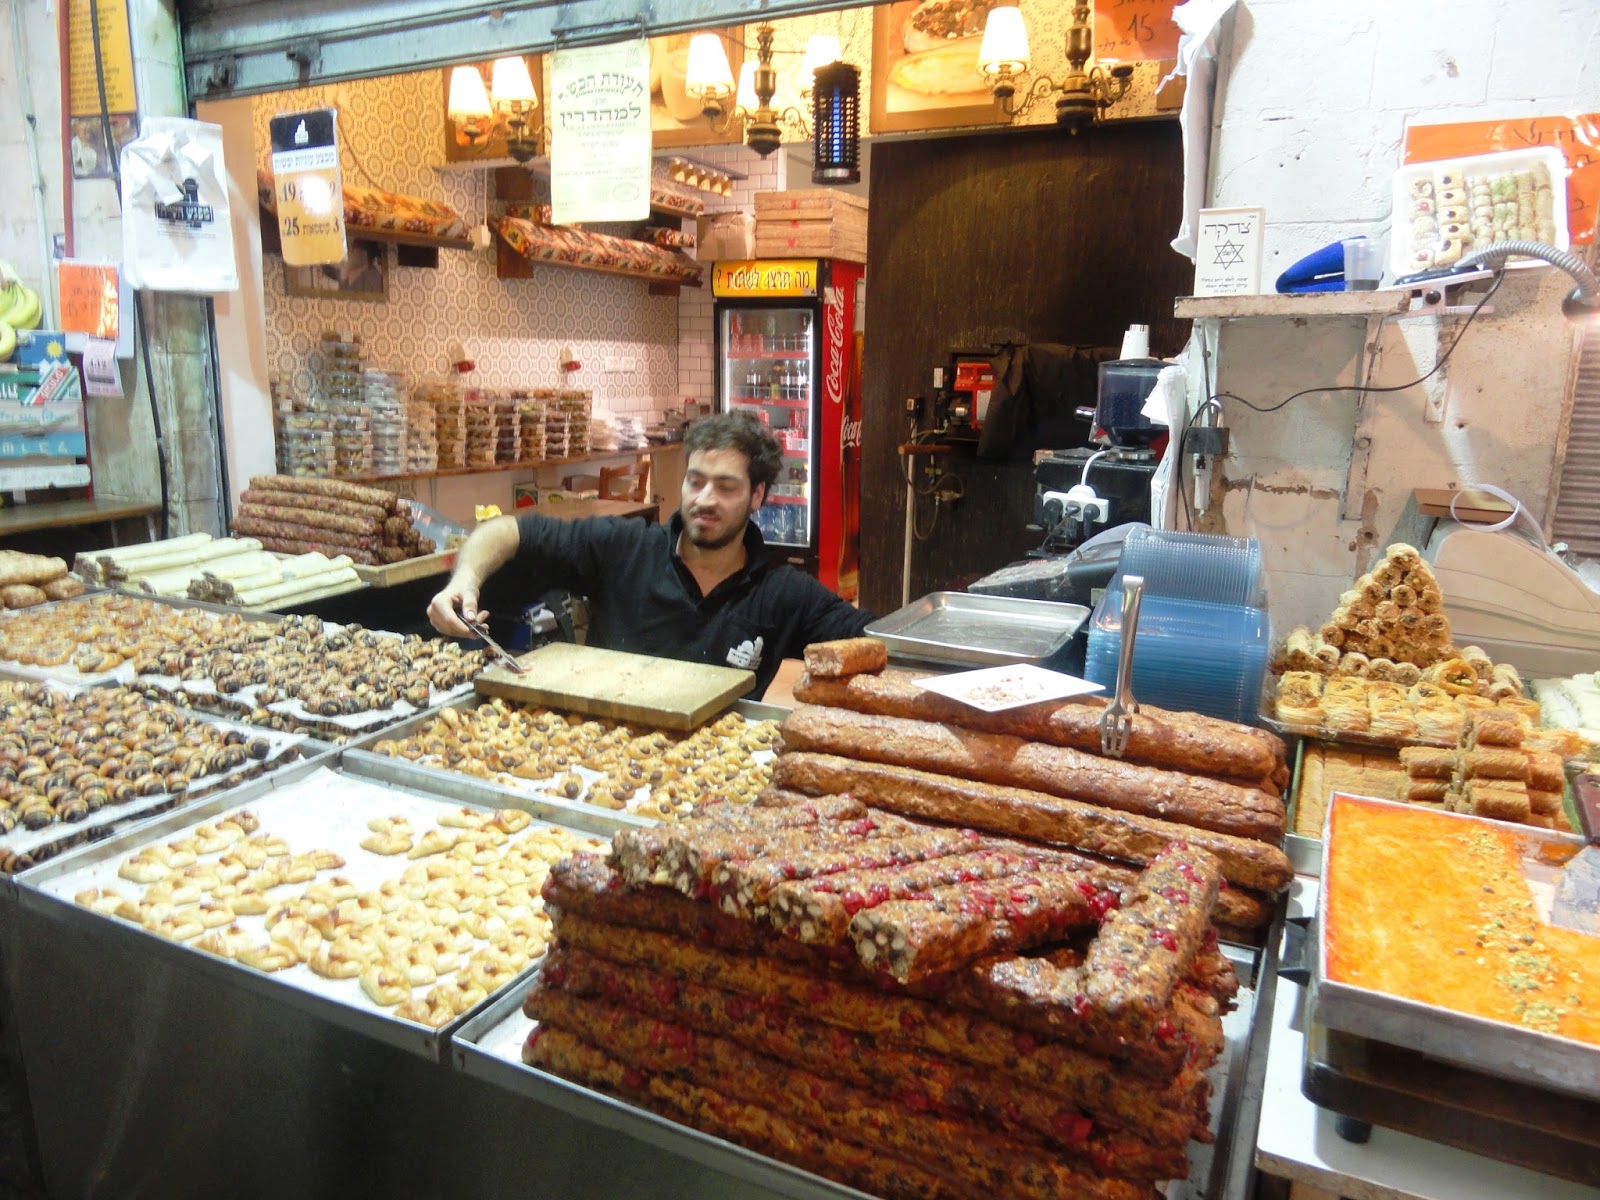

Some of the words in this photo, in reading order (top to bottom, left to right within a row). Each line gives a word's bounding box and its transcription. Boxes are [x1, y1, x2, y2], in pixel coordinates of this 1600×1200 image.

[1127, 13, 1154, 42] 15
[602, 72, 644, 98] תעודת
[560, 101, 641, 127] למהדרין
[284, 216, 300, 236] 25
[1204, 222, 1252, 241] צדקה
[795, 271, 810, 288] מה
